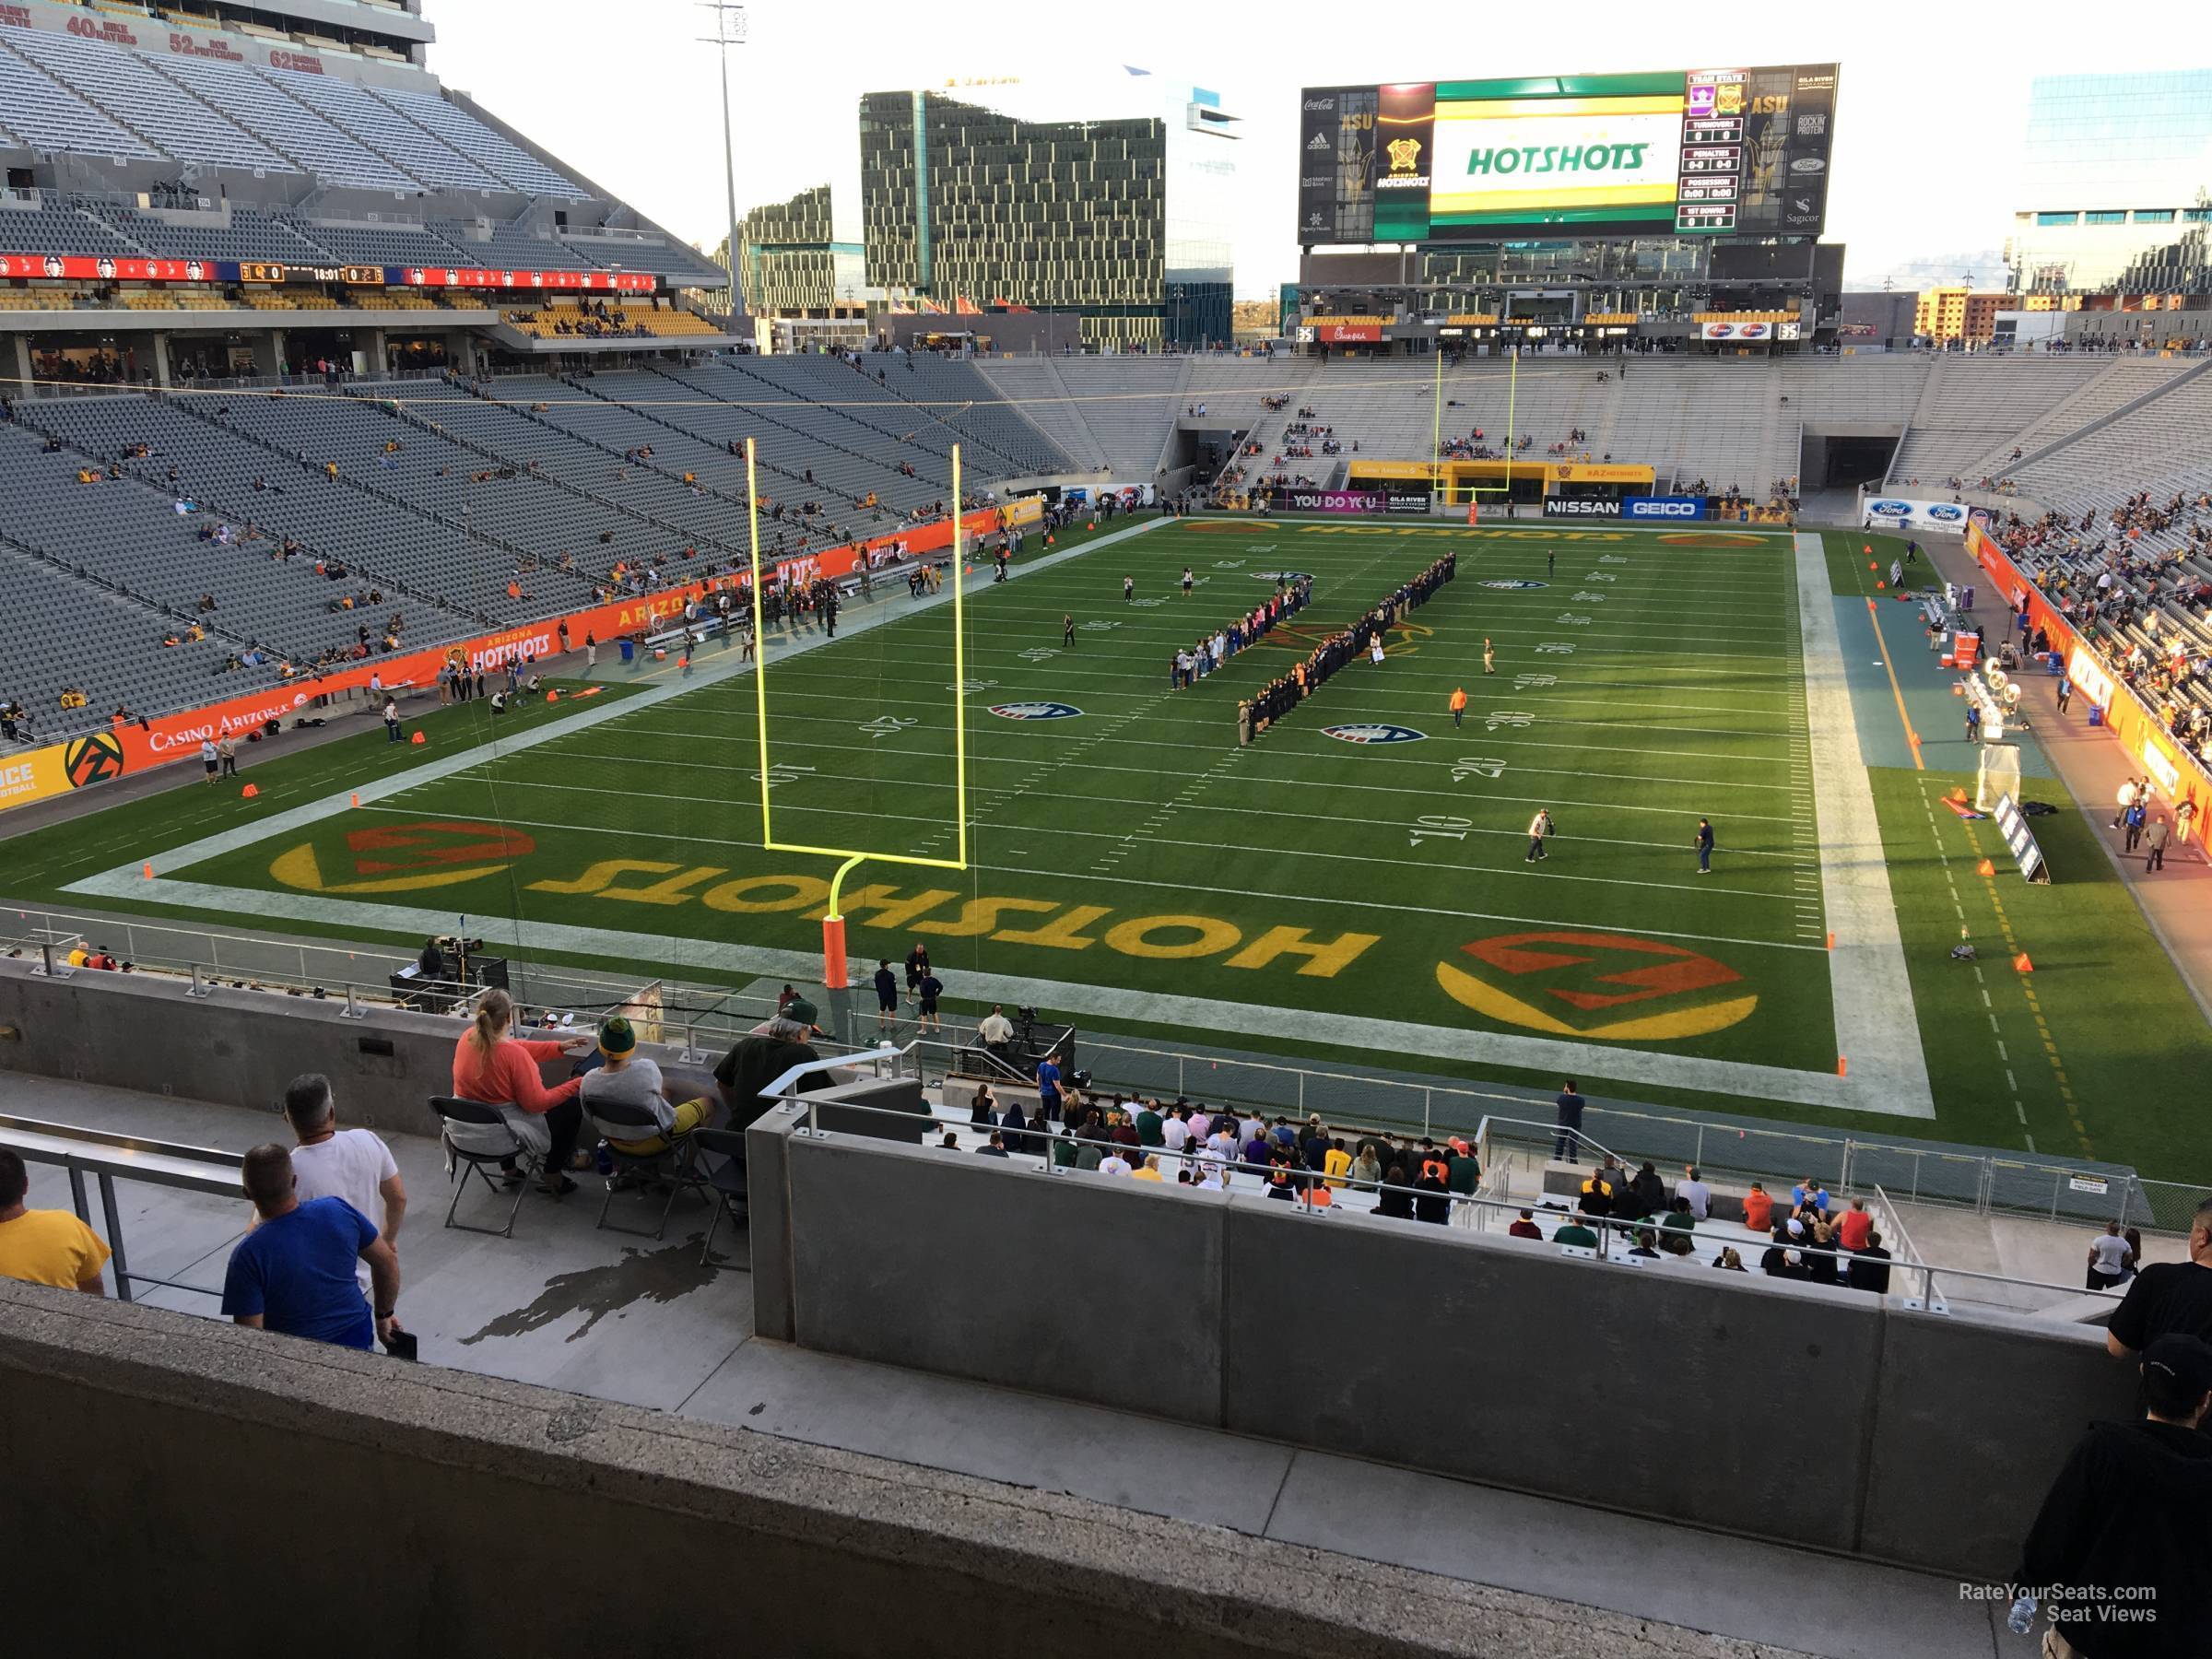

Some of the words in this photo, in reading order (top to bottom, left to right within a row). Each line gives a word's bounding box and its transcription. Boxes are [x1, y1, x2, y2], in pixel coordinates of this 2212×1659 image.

[66, 16, 96, 38] 40
[103, 21, 128, 33] MIKE
[170, 33, 194, 54] 52
[209, 39, 228, 50] RON
[194, 45, 243, 62] PRITCHARD
[270, 50, 293, 68] 62
[1752, 96, 1788, 114] ASU
[1341, 113, 1373, 131] ASU
[1693, 121, 1735, 129] TURNOVERS
[1695, 131, 1702, 141] 0
[1723, 130, 1730, 140] 0
[1797, 125, 1824, 135] PROTEIN
[1467, 143, 1649, 175] HOTSHOTS
[1693, 149, 1730, 158] PENALTIES
[1688, 160, 1704, 170] 0-0
[1716, 159, 1732, 169] 0-0
[1377, 177, 1430, 188] HOTSHOTS
[1688, 178, 1731, 187] POSSESSION
[1684, 189, 1704, 198] 0:00
[1712, 188, 1732, 197] 0:00
[1700, 206, 1726, 215] DOWNS
[1688, 217, 1695, 227] 0
[1715, 217, 1723, 226] 0
[1787, 213, 1819, 225] Sagicor
[272, 267, 279, 279] 0
[313, 268, 339, 280] 18:01
[350, 269, 357, 280] 0
[1298, 328, 1312, 341] 35
[1440, 328, 1463, 336] HOTSHOTS
[1782, 324, 1797, 339] 35
[1294, 495, 1322, 508] YOU
[1324, 496, 1347, 508] DO
[1547, 500, 1619, 514] NISSAN
[1632, 502, 1696, 515] GEICO
[1878, 503, 1906, 514] Ford
[1935, 507, 1957, 519] Ford
[1298, 524, 1635, 541] HOTSHOTS
[488, 629, 533, 647] ARIZONA
[473, 634, 549, 672] HOTSHOTS
[1513, 674, 1558, 687] 40
[858, 714, 919, 735] 20
[1485, 711, 1535, 728] 30
[149, 724, 214, 752] CASINO
[1451, 757, 1508, 779] 20
[1408, 815, 1474, 841] 10
[524, 859, 1382, 979] HOTSHOTS
